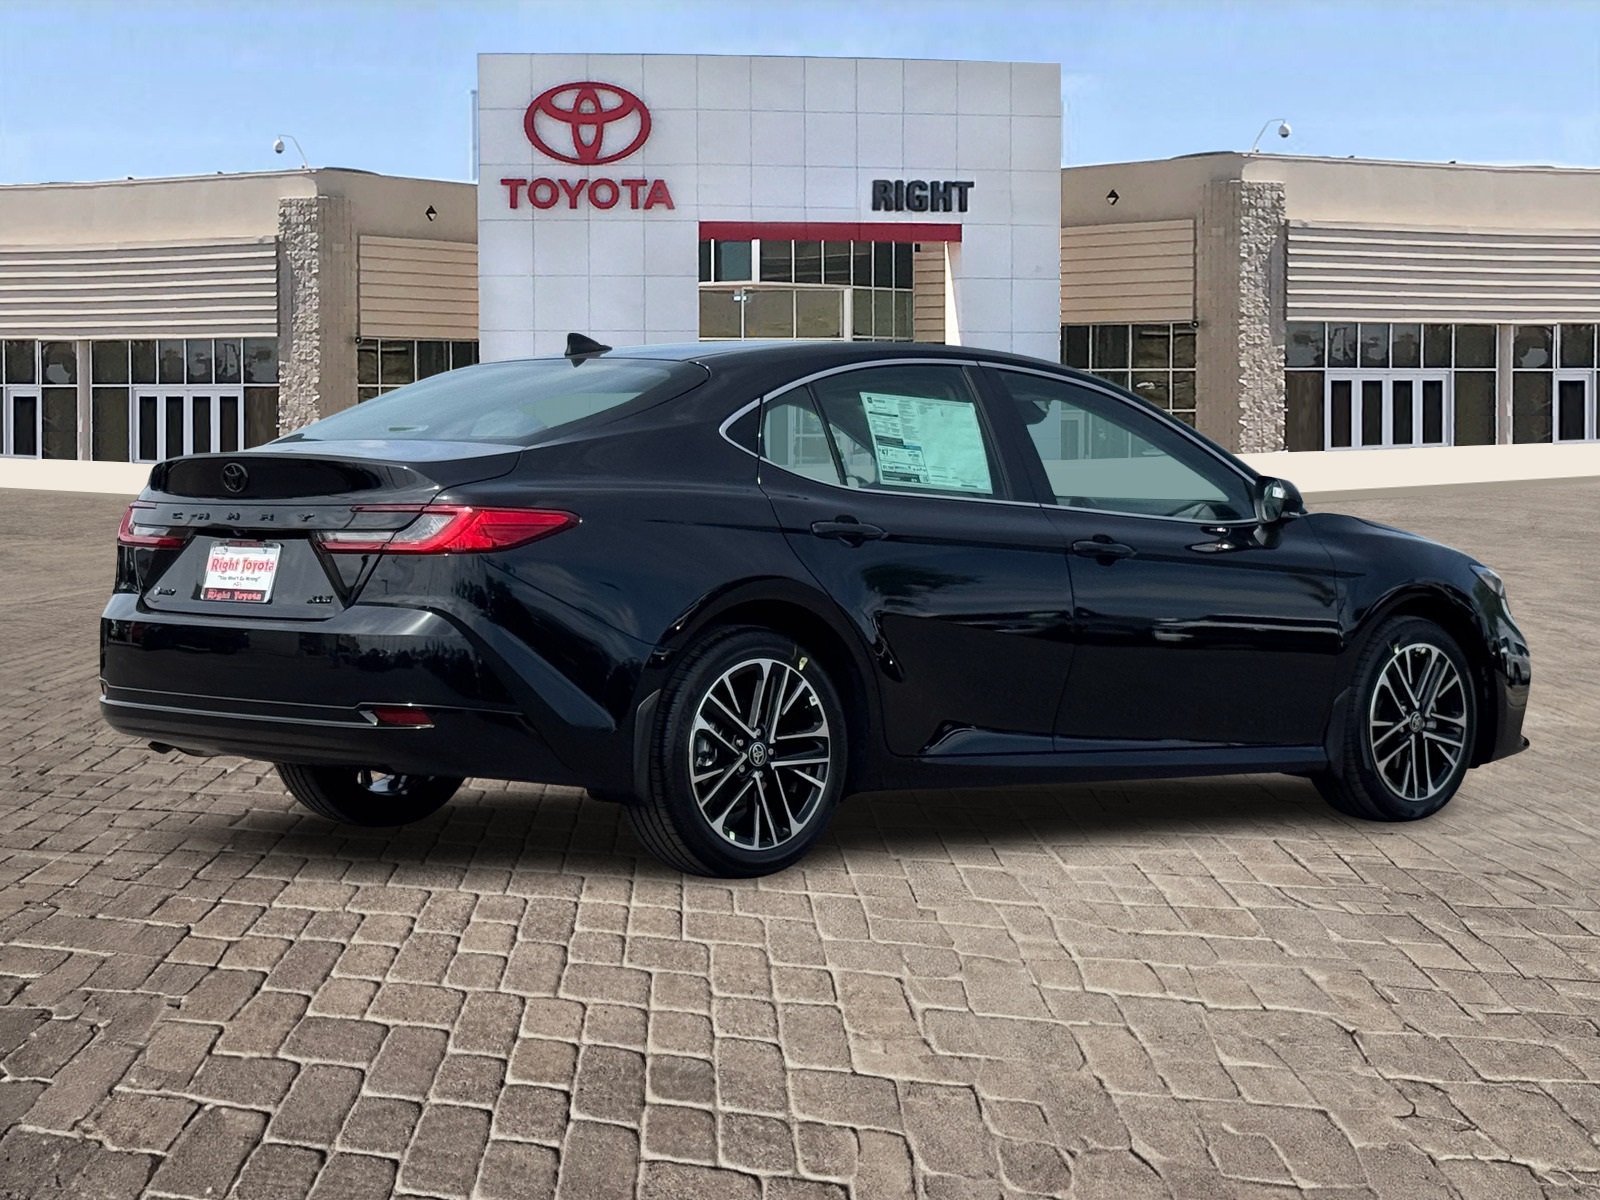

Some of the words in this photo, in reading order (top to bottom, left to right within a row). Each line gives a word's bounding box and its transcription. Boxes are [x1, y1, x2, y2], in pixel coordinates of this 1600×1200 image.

[500, 178, 676, 210] TOYOTA
[871, 179, 975, 213] RIGHT
[210, 558, 240, 573] Right
[241, 558, 275, 573] Toyota
[207, 589, 231, 600] Right
[234, 591, 262, 600] Toyota
